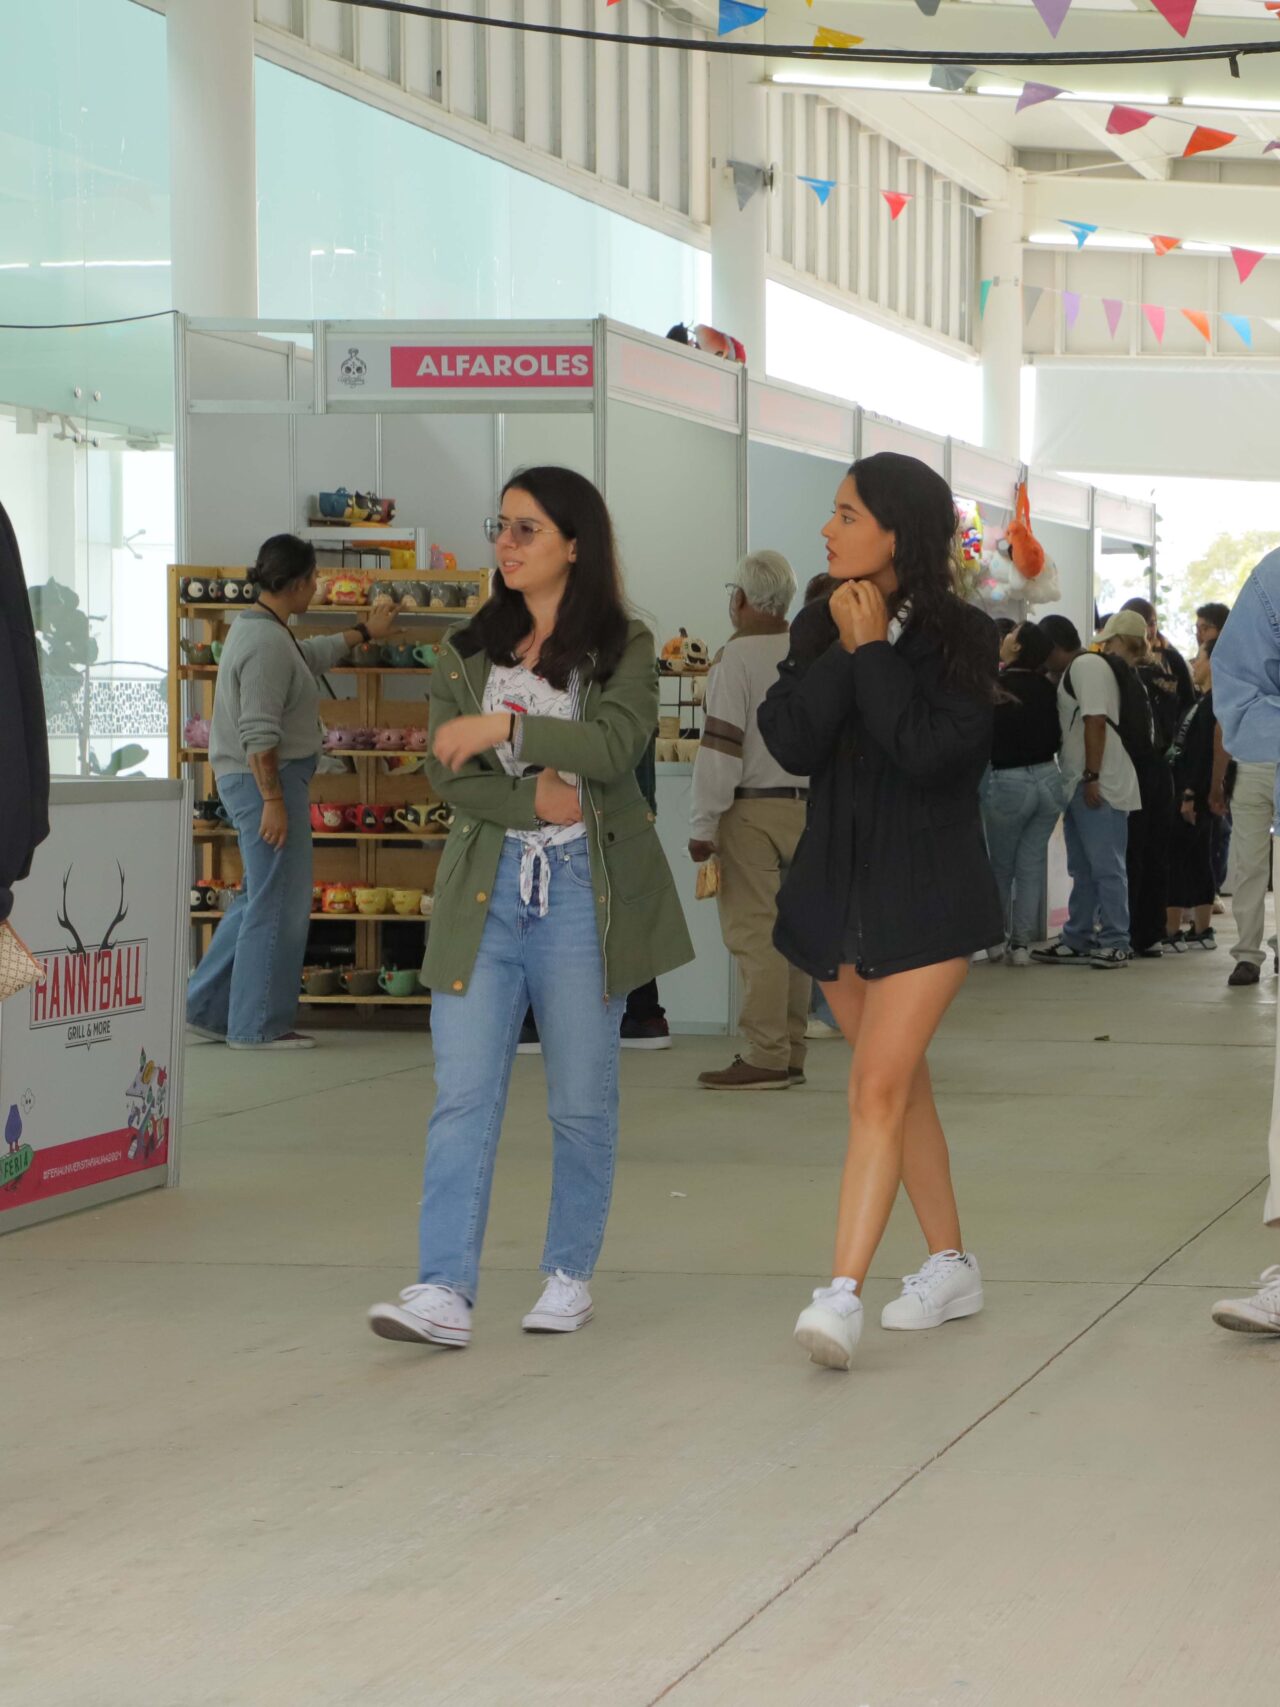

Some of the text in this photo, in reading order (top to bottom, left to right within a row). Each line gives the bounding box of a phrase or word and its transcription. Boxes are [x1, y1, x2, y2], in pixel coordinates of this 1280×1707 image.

[416, 354, 589, 377] ALFAROLES
[34, 946, 142, 1021] HANNIBALL
[67, 1020, 111, 1040] GRILL & MORE
[4, 1151, 28, 1179] FERIA
